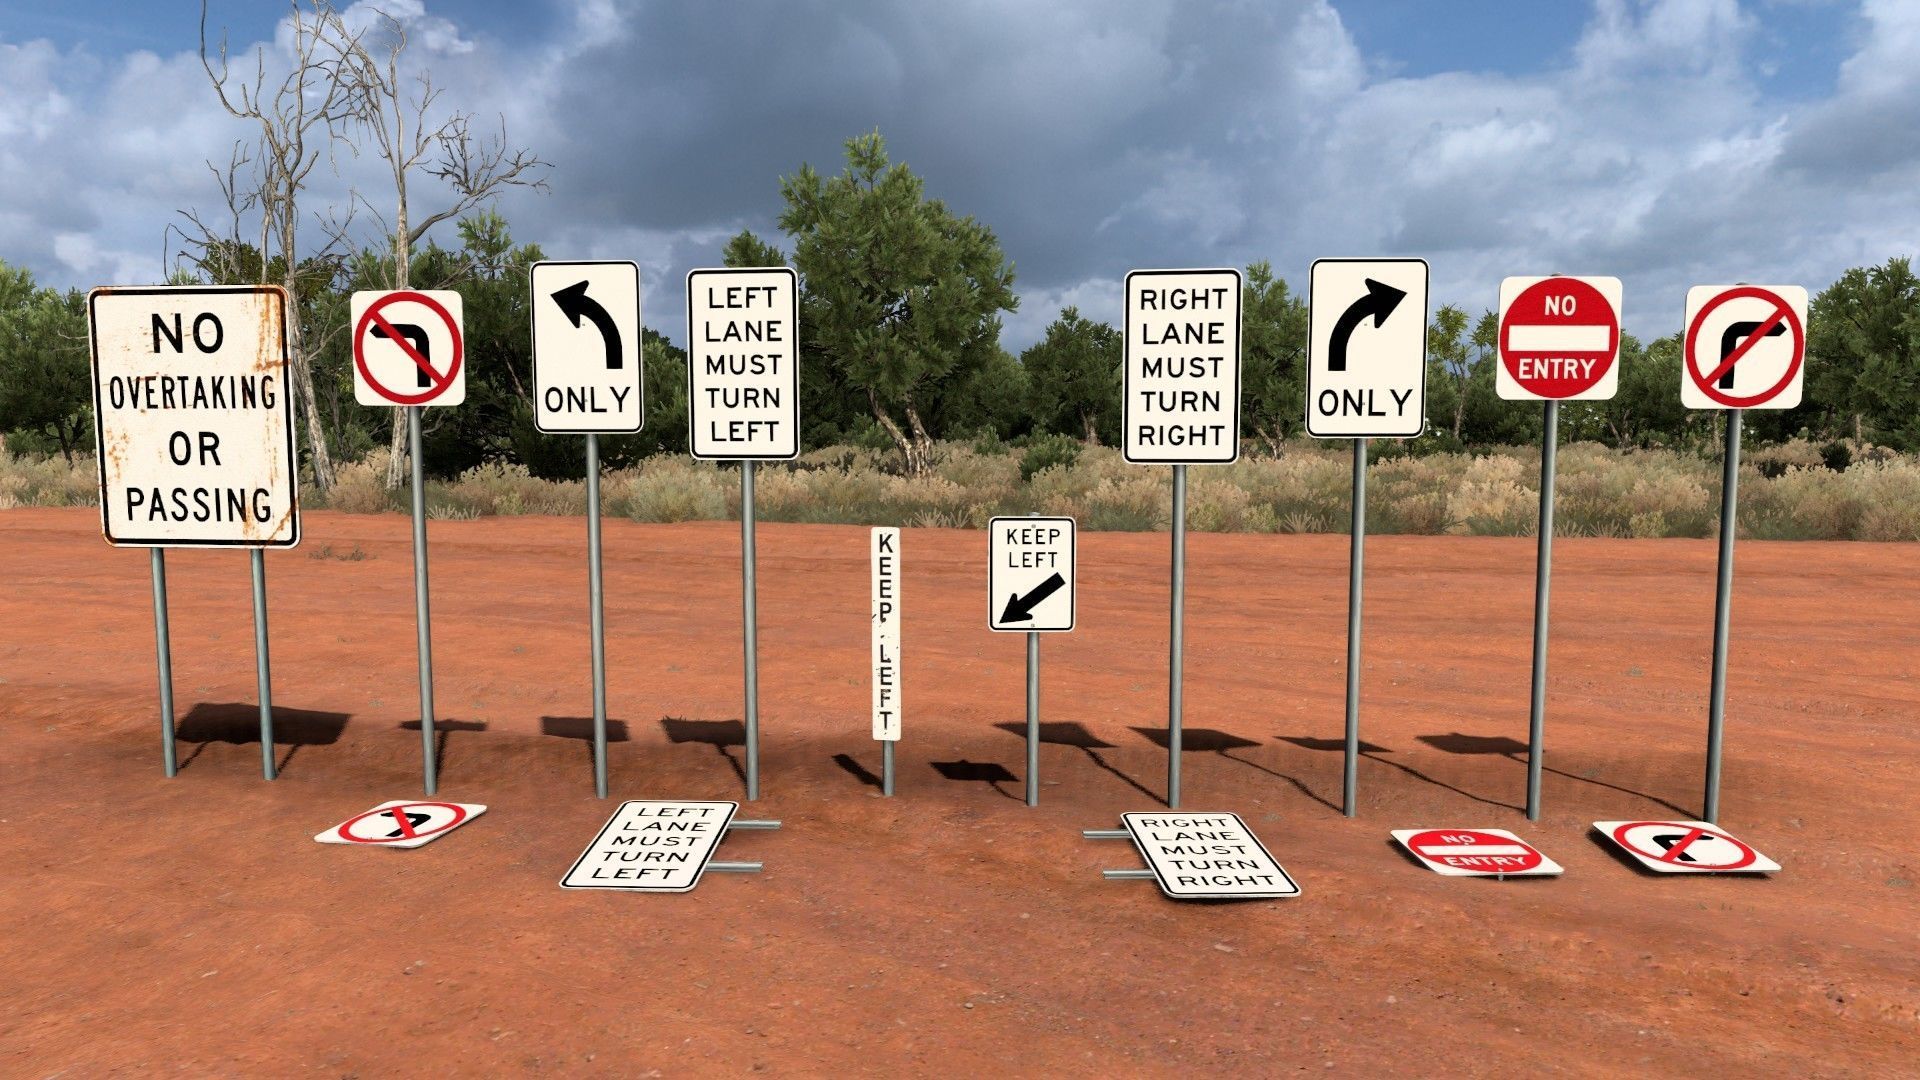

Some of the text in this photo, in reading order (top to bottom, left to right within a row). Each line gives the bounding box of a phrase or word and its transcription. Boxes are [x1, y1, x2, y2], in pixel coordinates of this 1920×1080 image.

[709, 286, 778, 309] LEFT
[1140, 288, 1229, 311] RIGHT
[1544, 295, 1577, 317] NO
[152, 312, 224, 354] NO
[705, 320, 783, 343] LANE
[1142, 322, 1225, 345] LANE
[706, 354, 783, 377] MUST
[1142, 356, 1224, 379] MUST
[1518, 358, 1598, 381] ENTRY
[109, 375, 277, 411] OVERTAKING
[544, 386, 631, 414] ONLY
[705, 387, 781, 410] TURN
[1141, 390, 1221, 413] TURN
[1318, 389, 1414, 417] ONLY
[710, 421, 780, 443] LEFT
[1138, 424, 1226, 447] RIGHT
[168, 431, 222, 467] OR
[127, 488, 272, 524] PASSING
[1006, 528, 1061, 545] KEEP
[1008, 552, 1058, 568] LEFT
[879, 533, 893, 731] KEEP LEFT
[637, 808, 715, 818] LEFT
[1140, 818, 1228, 828] RIGHT
[622, 821, 711, 832] LANE
[1151, 831, 1240, 841] LANE
[611, 836, 703, 847] MUST
[1160, 845, 1247, 855] MUST
[1441, 834, 1476, 844] NO
[603, 851, 690, 862] TURN
[1168, 860, 1261, 870] TURN
[1443, 855, 1528, 867] ENTRY
[592, 868, 680, 880] LEFT
[1176, 875, 1275, 886] RIGHT
